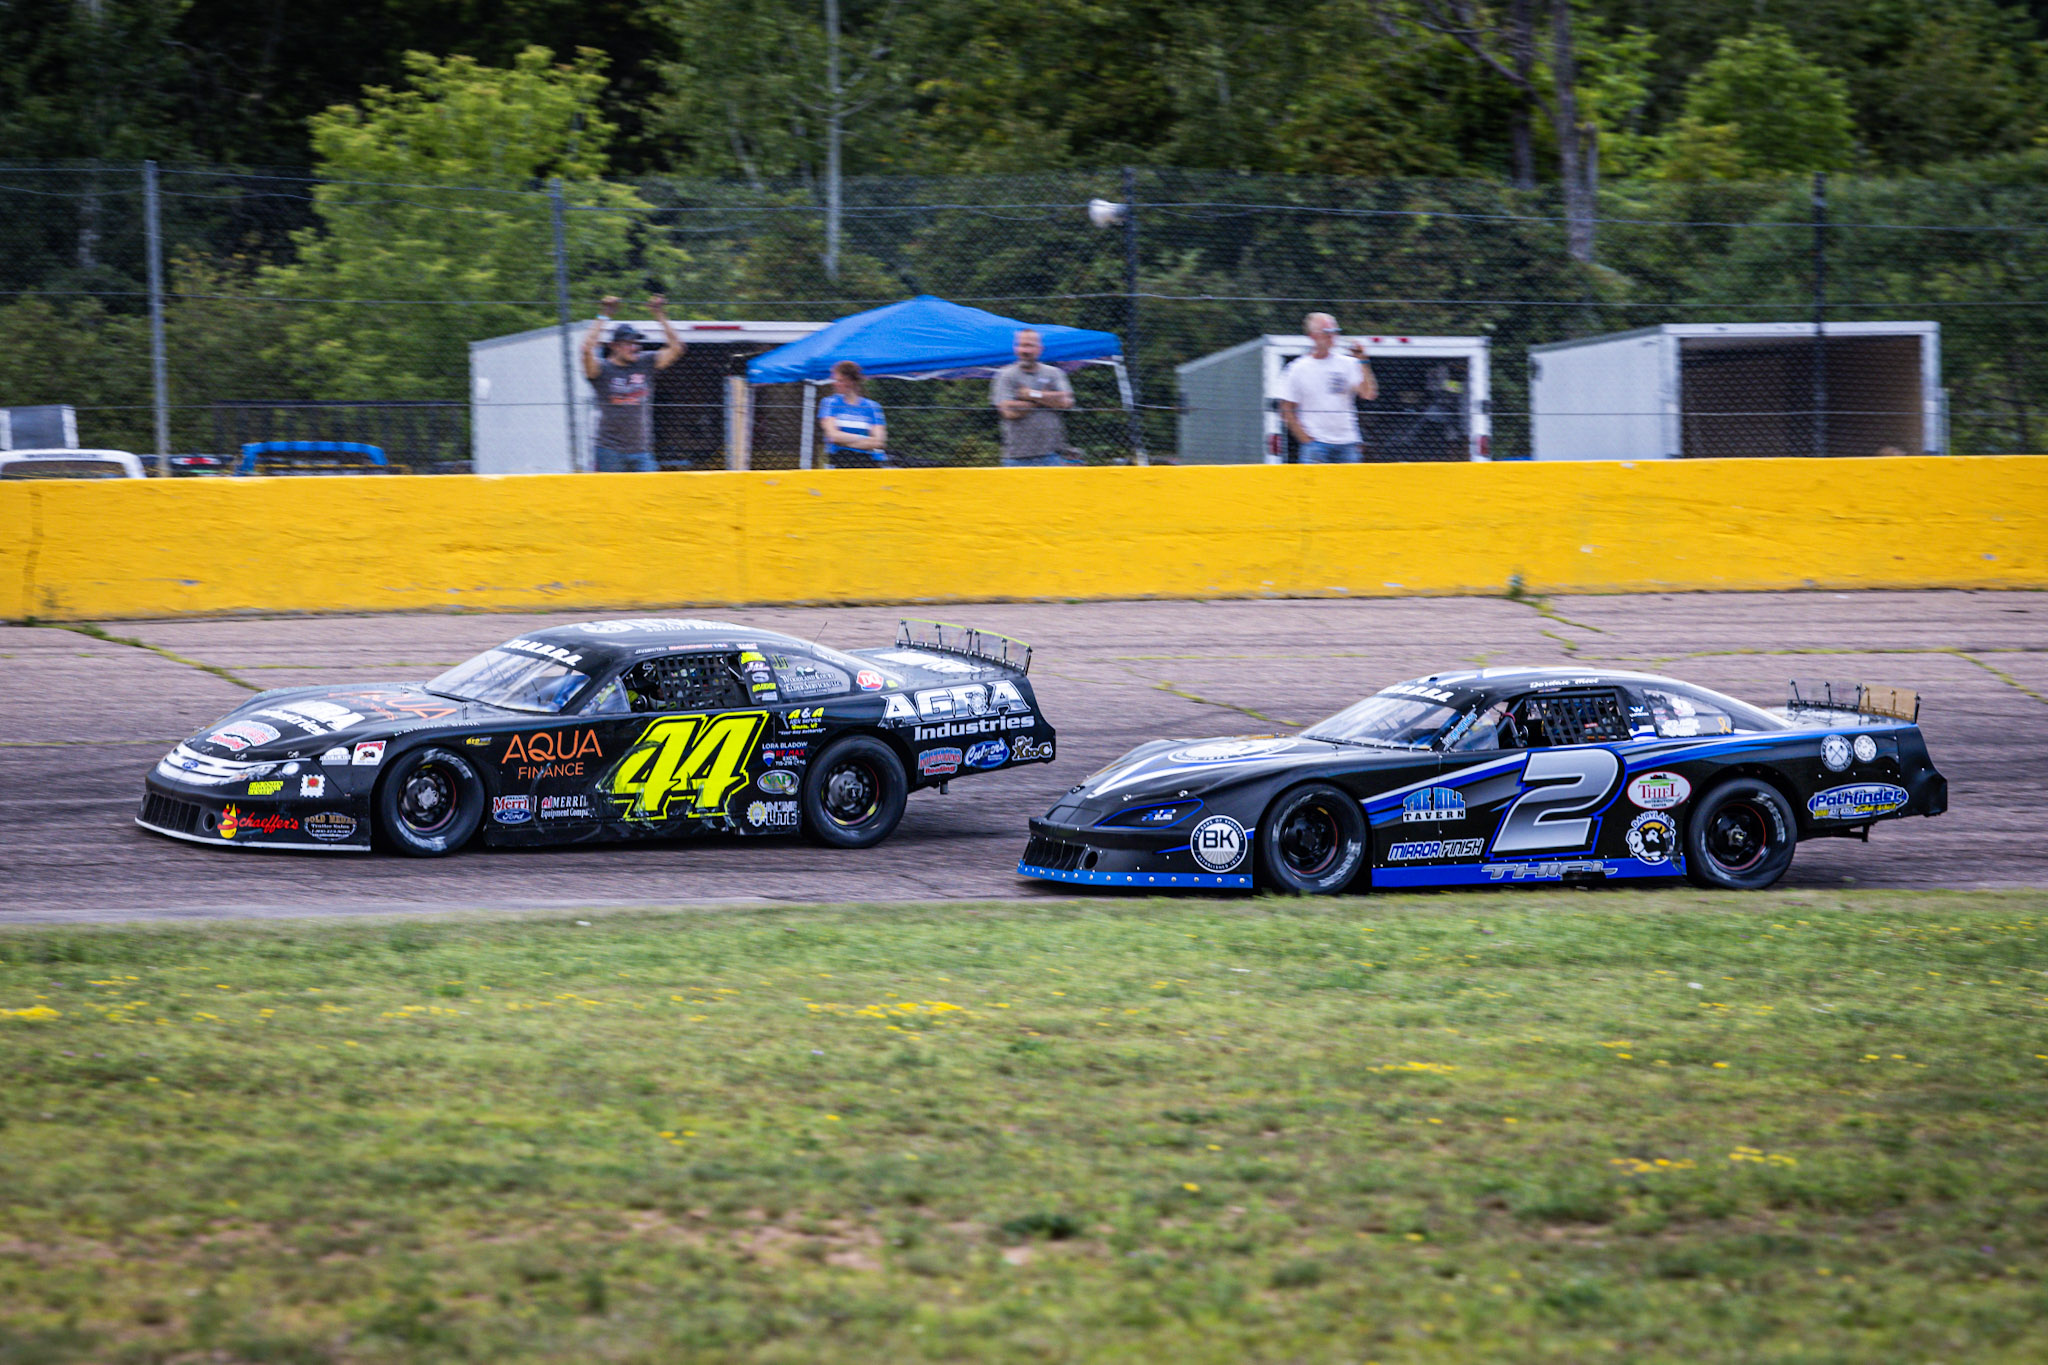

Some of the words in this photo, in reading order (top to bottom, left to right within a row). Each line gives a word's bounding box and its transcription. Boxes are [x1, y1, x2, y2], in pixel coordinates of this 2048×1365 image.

[788, 709, 801, 719] A
[801, 707, 811, 718] &
[812, 707, 824, 717] A
[914, 715, 1035, 741] Industries
[501, 729, 603, 764] AQUA
[776, 749, 805, 757] RE/MAX
[780, 741, 808, 749] BLADOW
[518, 762, 584, 779] FINANCE
[606, 711, 769, 820] 44
[1403, 787, 1431, 812] THE
[1433, 787, 1466, 811] HILL
[1490, 747, 1620, 854] 2
[1815, 788, 1902, 807] Pathfinder
[217, 806, 299, 834] Schaeffer's
[1404, 810, 1465, 820] TAVERN
[1203, 829, 1234, 848] BK
[1388, 840, 1441, 861] MIRROR
[1441, 838, 1485, 857] FINISH
